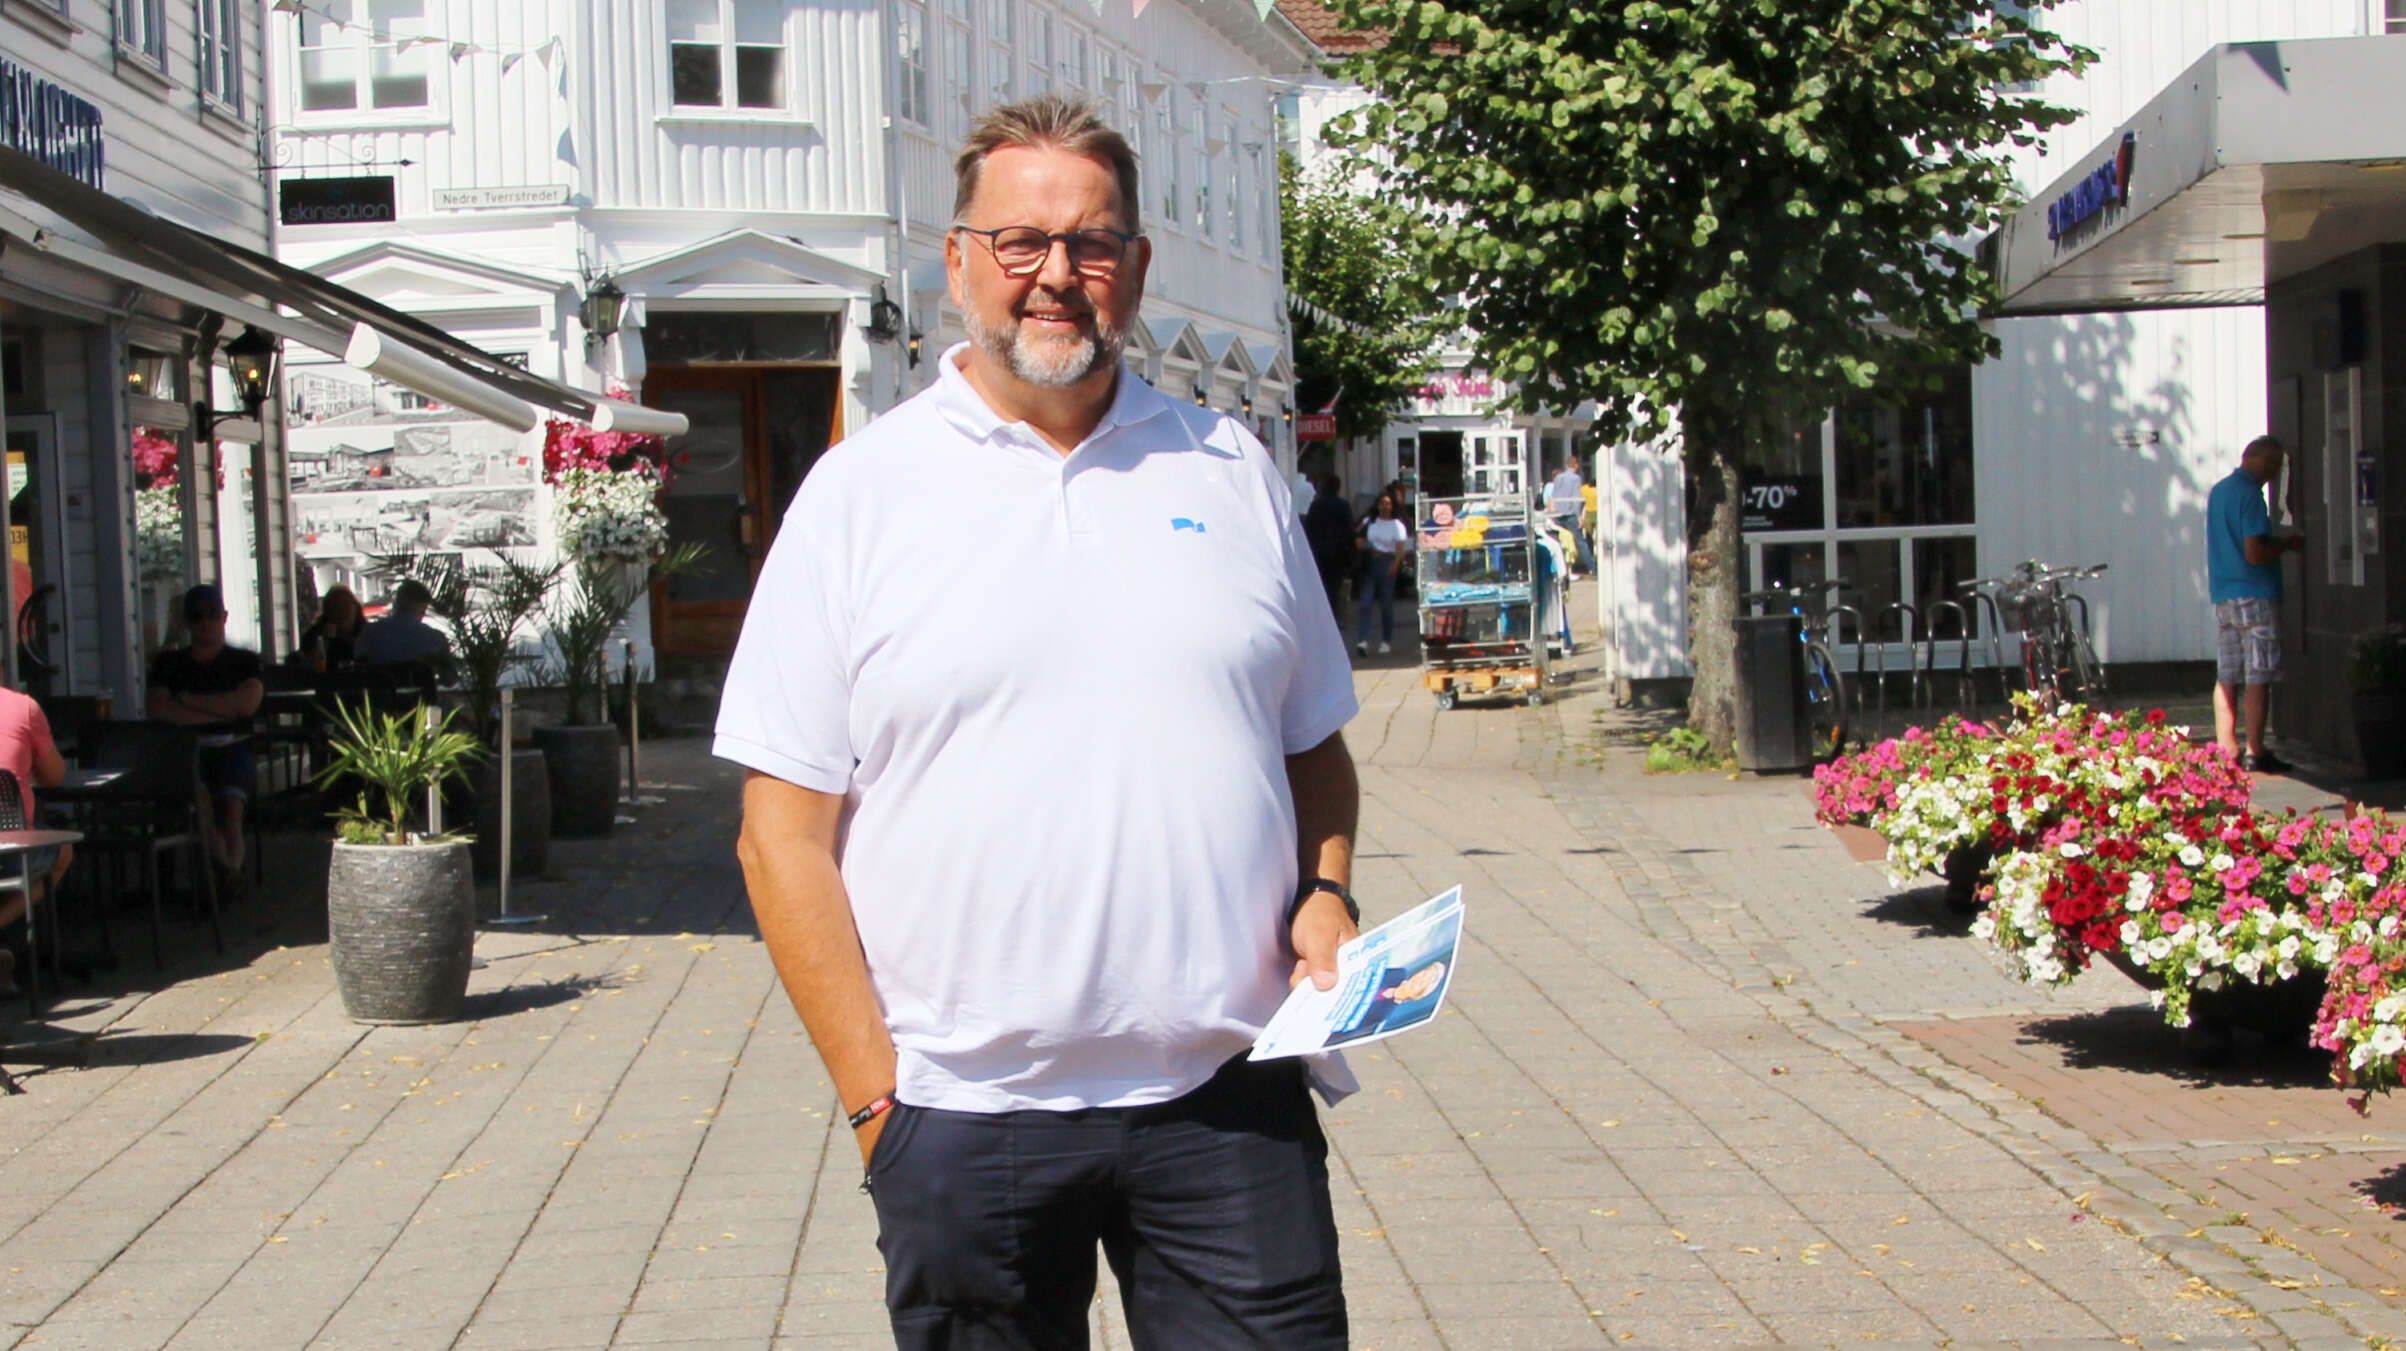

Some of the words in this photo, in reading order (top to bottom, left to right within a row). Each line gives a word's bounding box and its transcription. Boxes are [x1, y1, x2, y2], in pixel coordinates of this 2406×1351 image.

[443, 194, 478, 205] Nedre
[485, 190, 558, 203] Tverrstredet
[288, 201, 390, 221] skinsation
[1298, 420, 1331, 433] DIESEL
